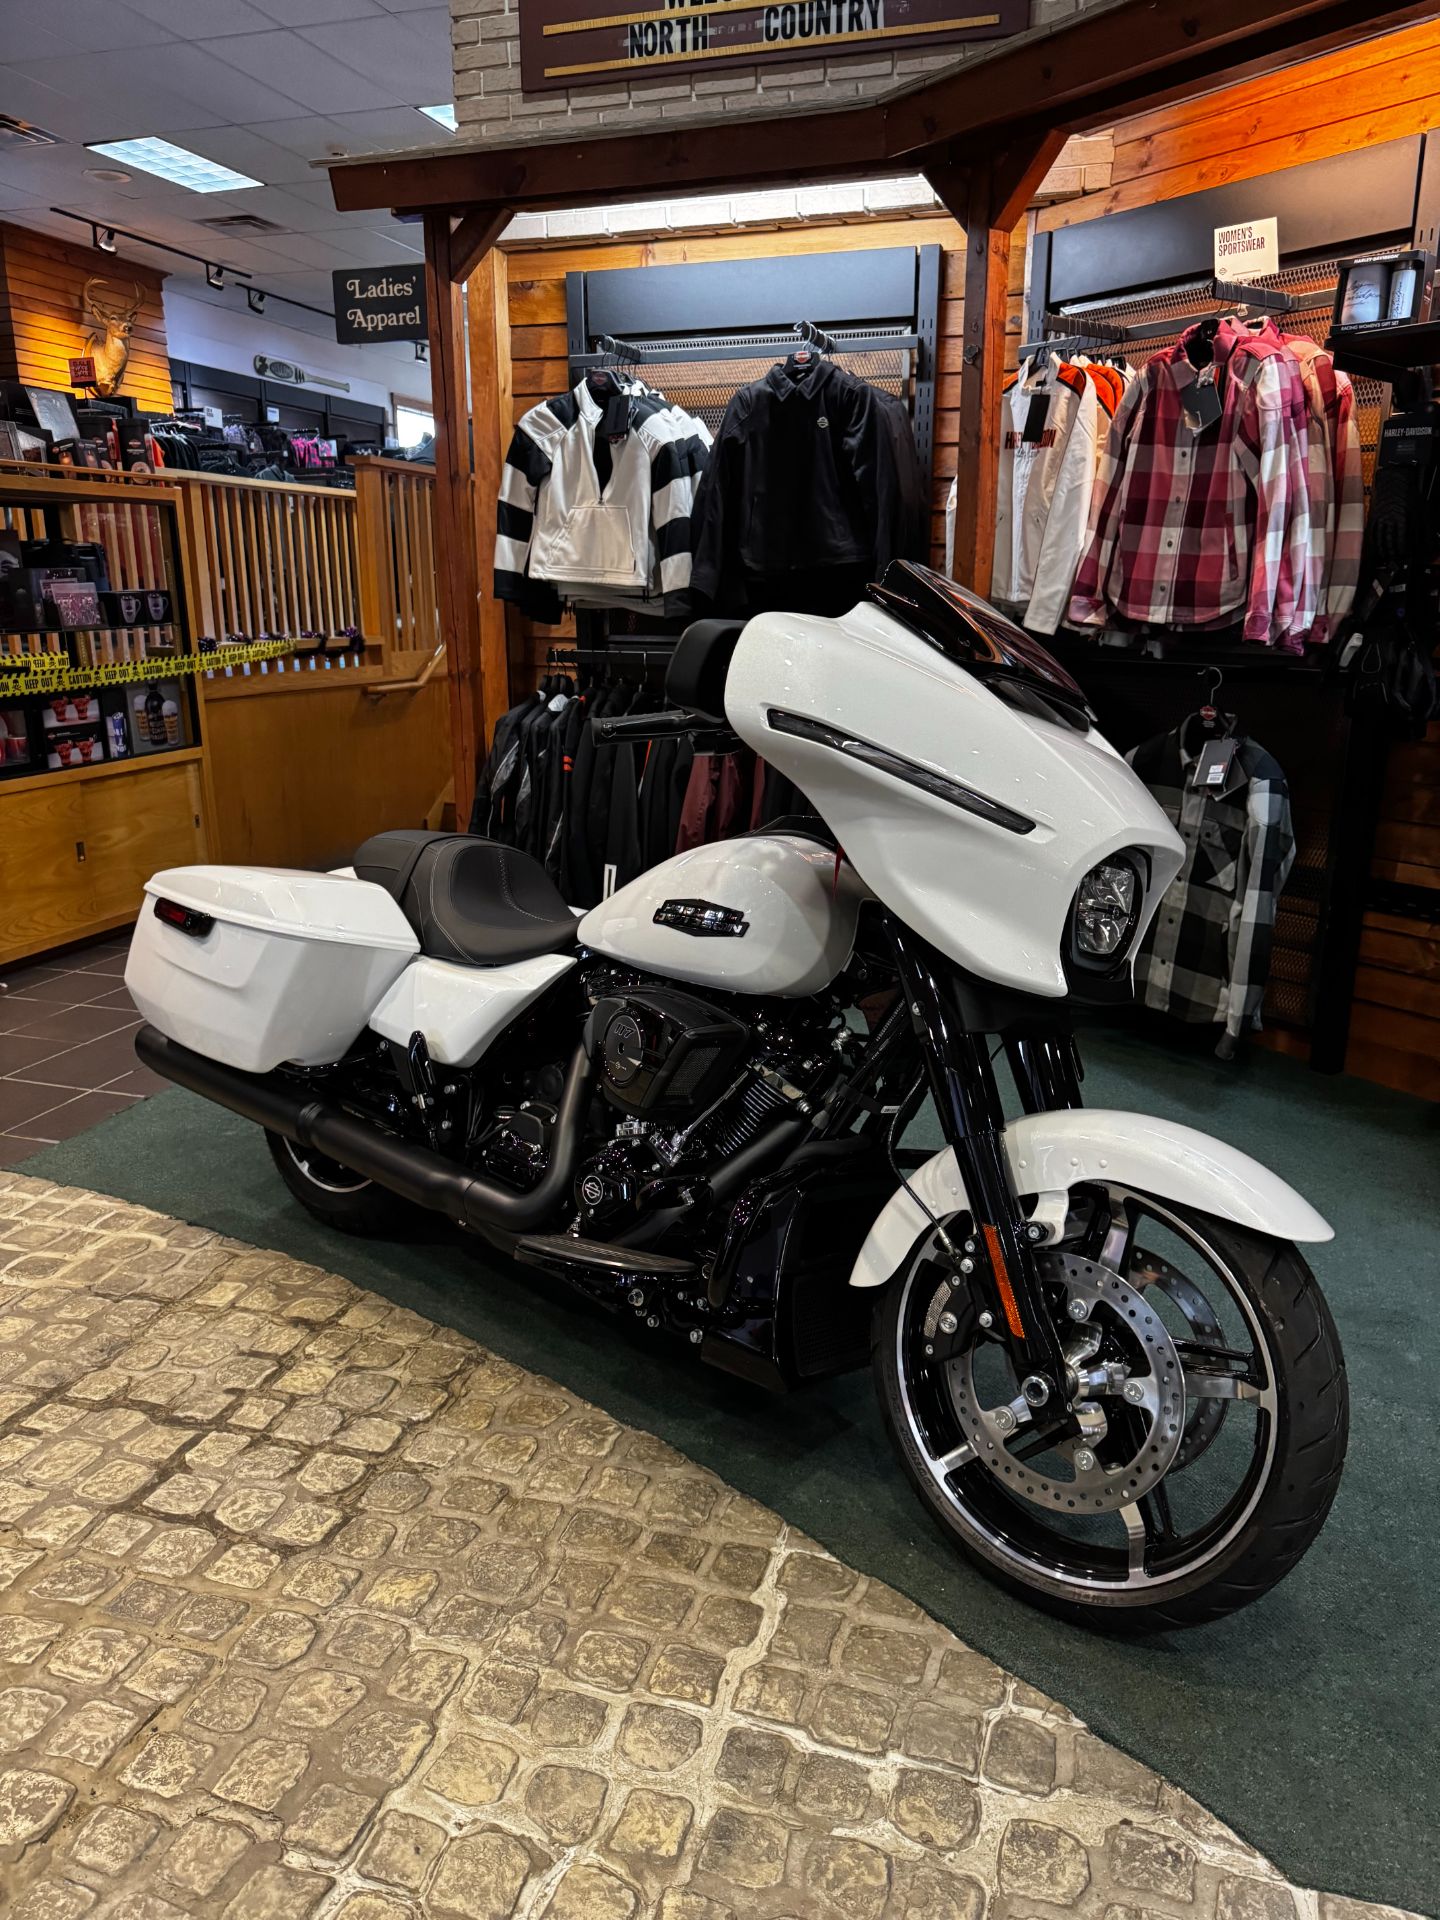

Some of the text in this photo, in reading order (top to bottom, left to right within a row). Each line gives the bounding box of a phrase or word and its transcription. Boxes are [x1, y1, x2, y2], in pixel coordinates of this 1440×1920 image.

[629, 0, 881, 58] NORTH COUNTRY
[1218, 227, 1253, 244] WOMEN'S
[1218, 237, 1266, 257] SPORTSWEAR
[346, 275, 417, 299] Ladies'
[346, 305, 422, 332] Apparel
[1384, 426, 1432, 438] HARLEY-DAVIDSON
[24, 679, 39, 690] KEEP
[41, 677, 53, 687] OUT
[68, 673, 92, 685] CAUTION
[104, 669, 118, 680] KEEP
[119, 668, 130, 678] OUT
[142, 664, 164, 675] CAUTION
[174, 661, 185, 671] KEEP
[186, 659, 196, 670] OUT
[614, 1023, 636, 1038] 117
